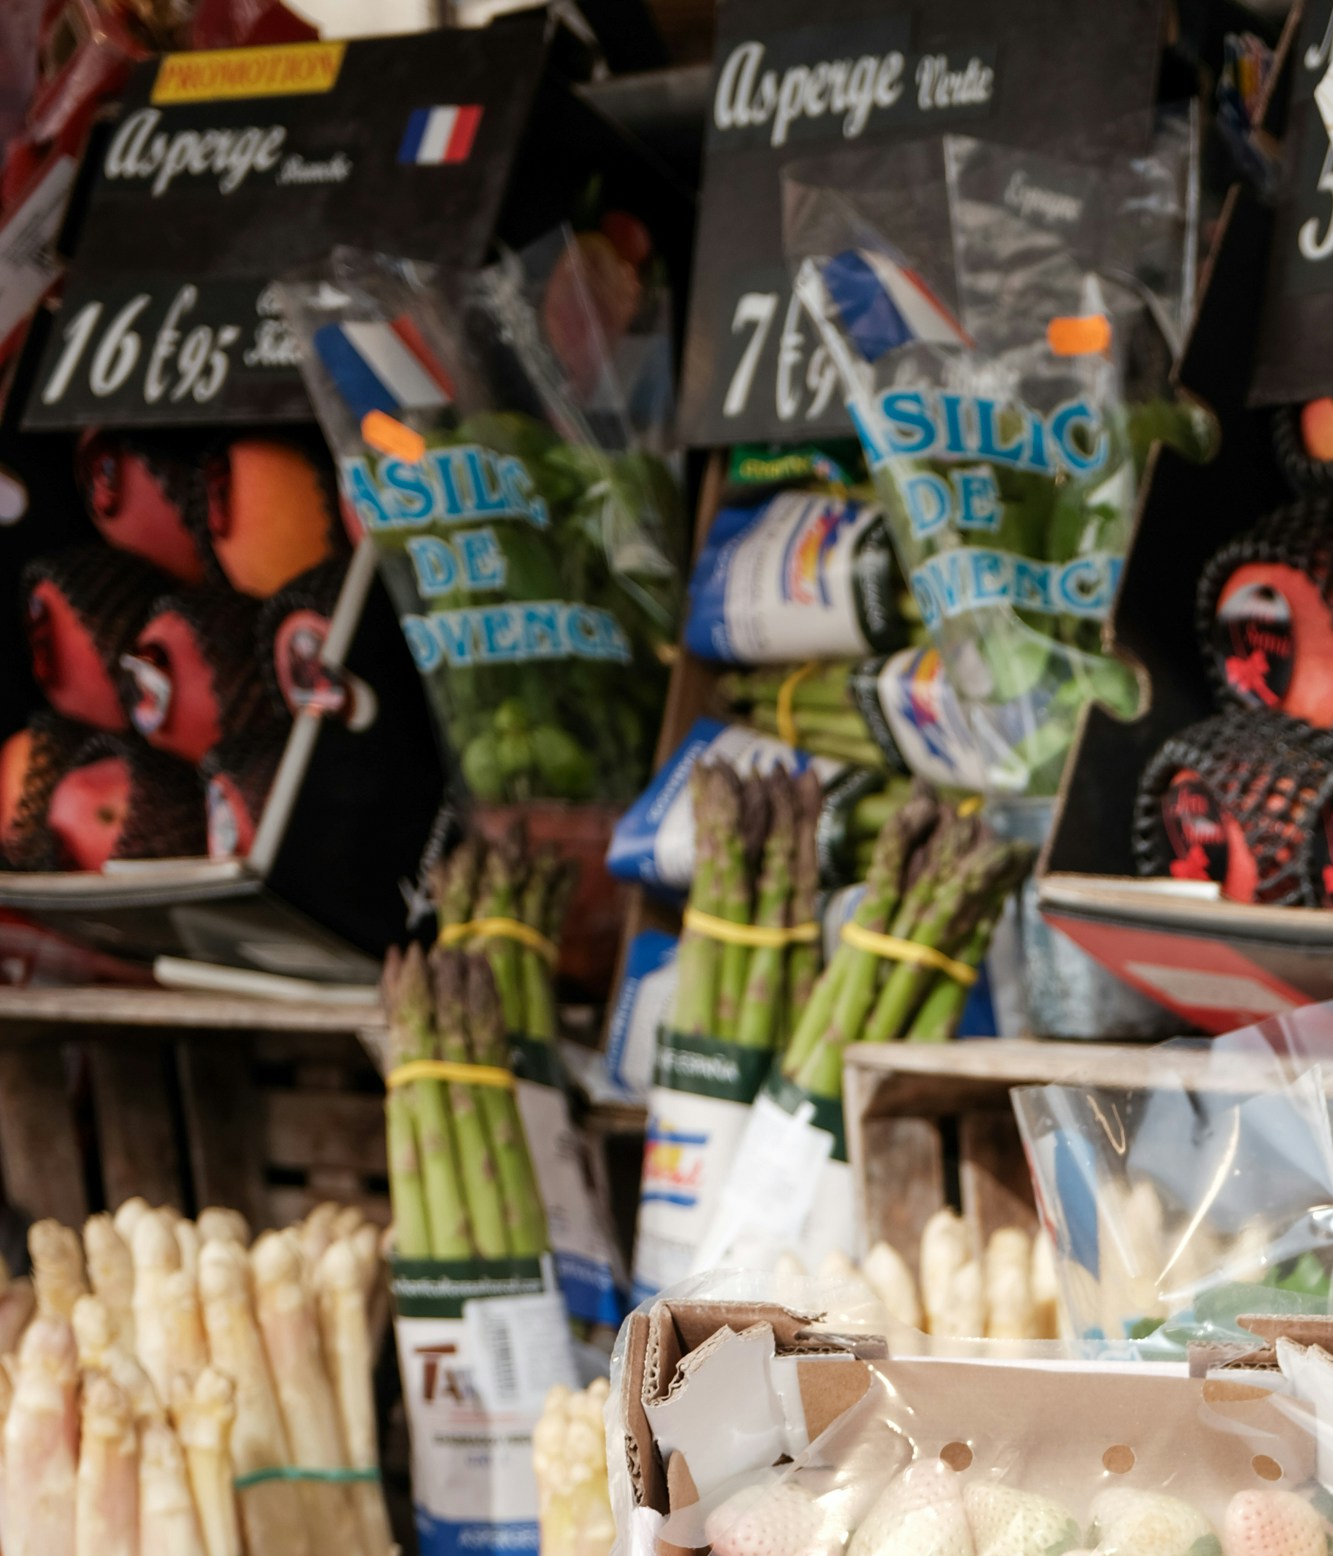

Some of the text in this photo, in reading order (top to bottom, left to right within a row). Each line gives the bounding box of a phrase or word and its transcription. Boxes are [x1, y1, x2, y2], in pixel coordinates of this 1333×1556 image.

[162, 49, 337, 92] PROMOTION
[714, 41, 904, 148] Asperge
[104, 107, 287, 197] Asperge
[904, 463, 1003, 539] DE
[405, 526, 508, 599] DE
